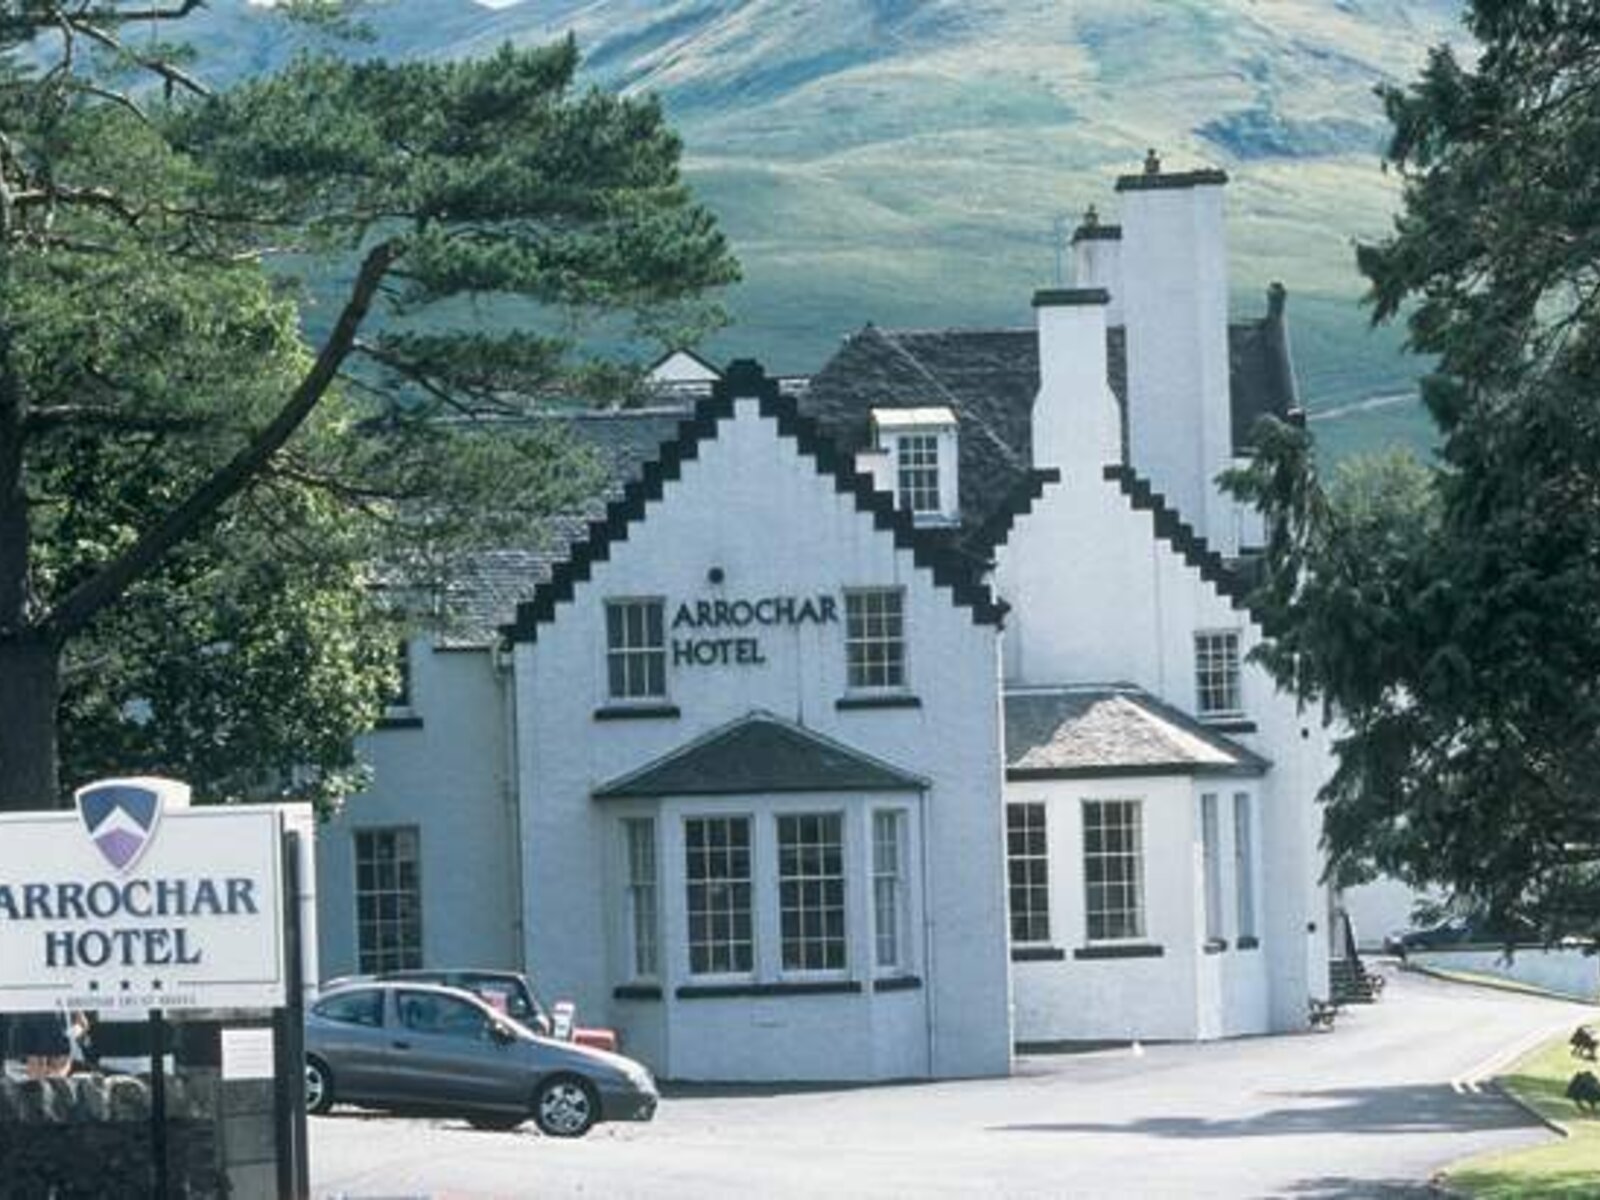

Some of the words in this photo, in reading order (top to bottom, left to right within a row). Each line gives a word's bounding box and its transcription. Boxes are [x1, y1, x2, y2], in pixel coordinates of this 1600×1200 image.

[672, 596, 838, 628] ARROCHAR
[672, 638, 766, 667] HOTEL
[0, 878, 259, 920] ARROCHAR
[45, 928, 202, 968] HOTEL
